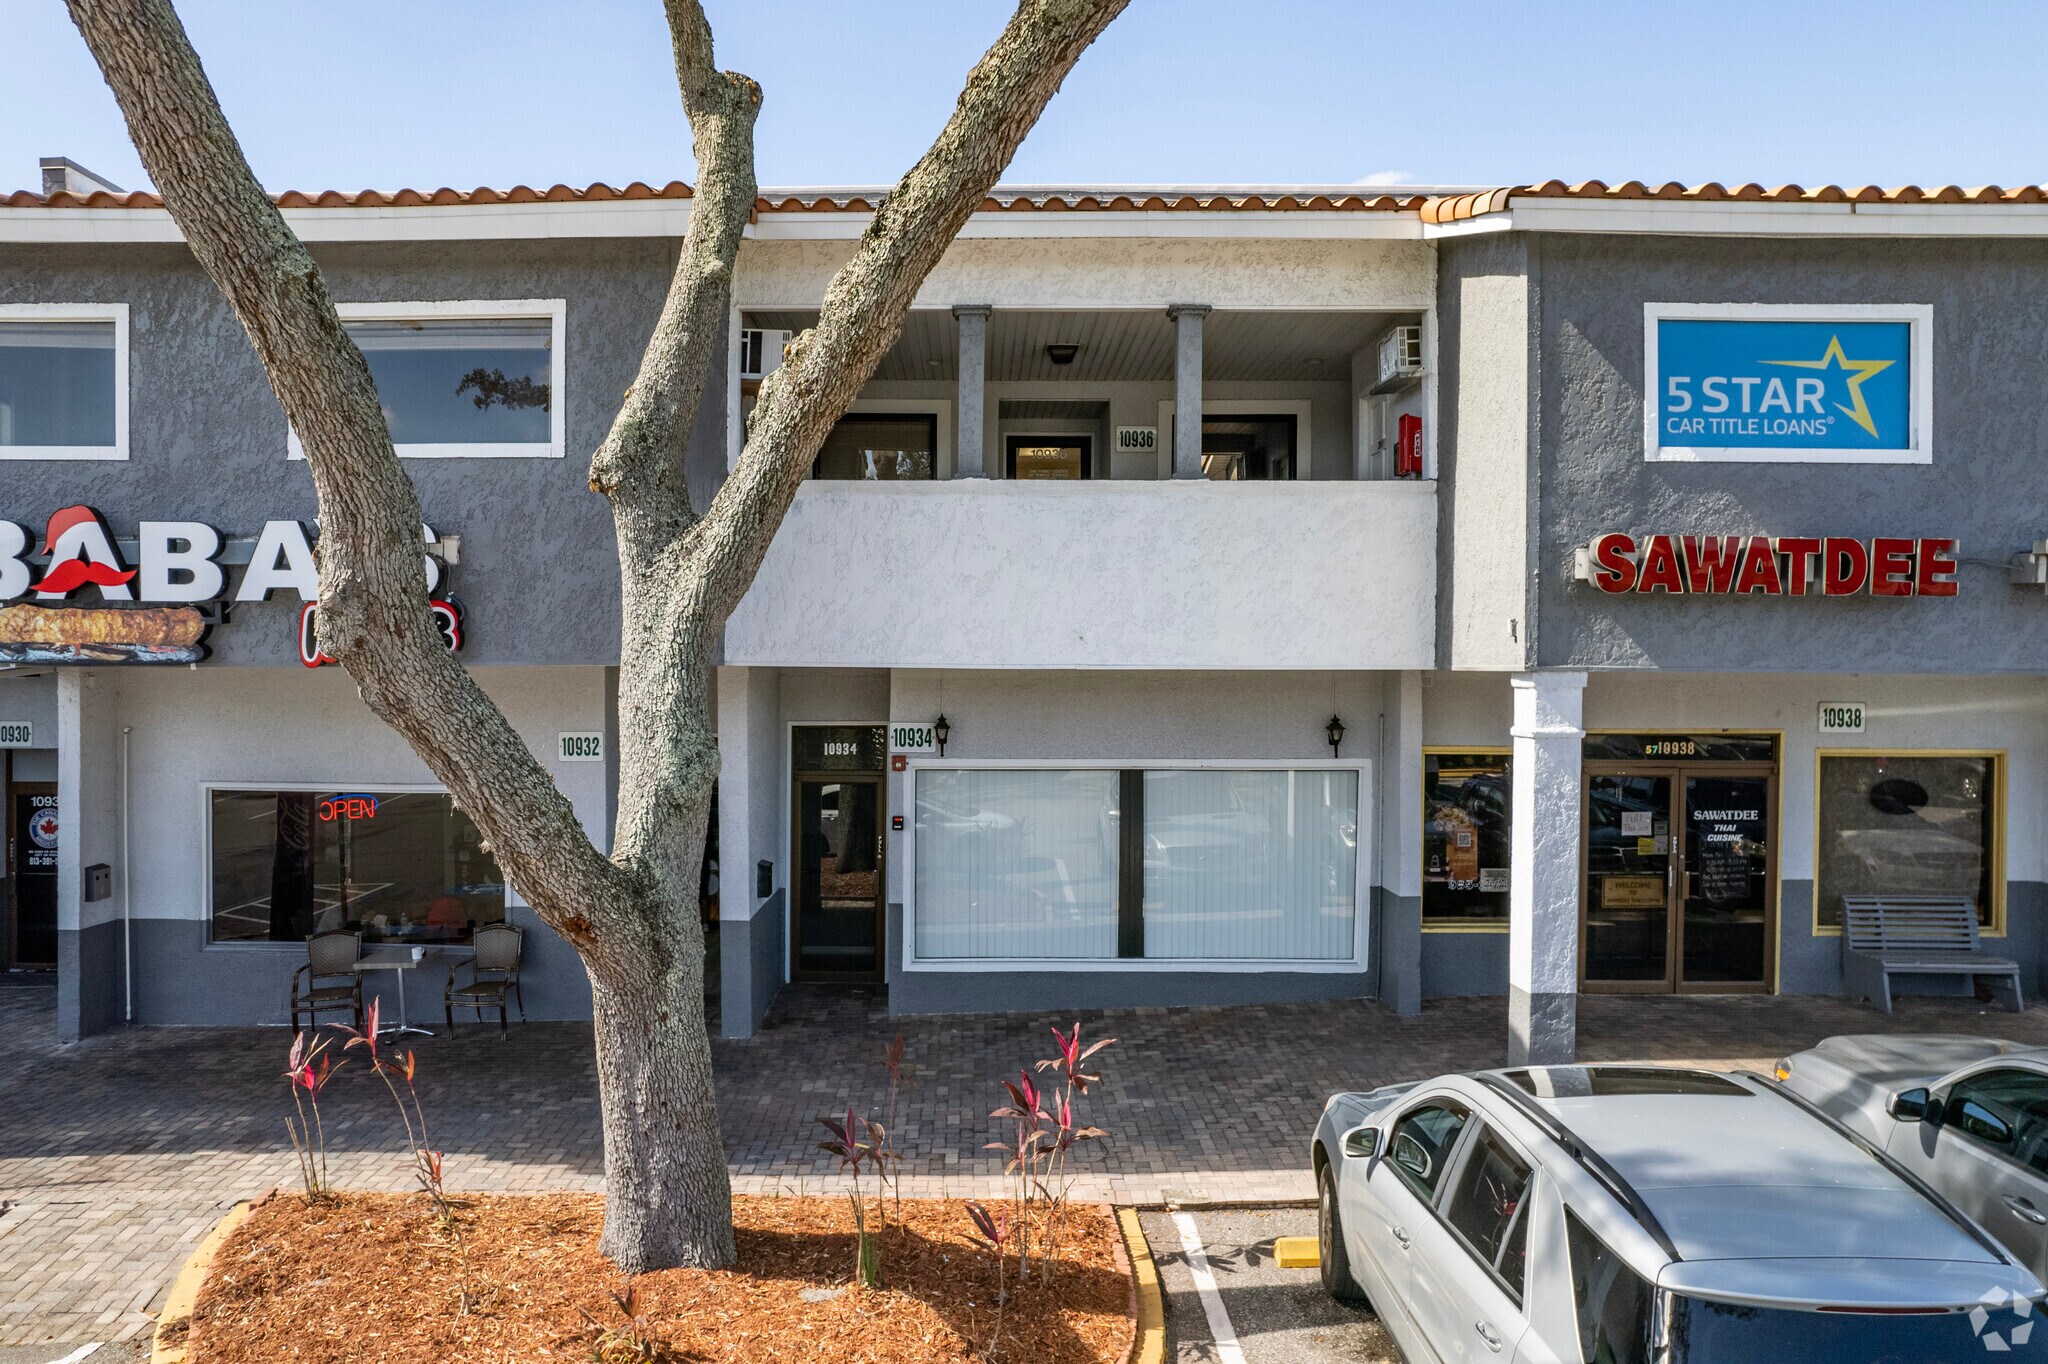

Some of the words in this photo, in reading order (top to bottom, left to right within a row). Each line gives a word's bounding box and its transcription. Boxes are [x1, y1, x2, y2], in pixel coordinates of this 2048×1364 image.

[1667, 376, 1693, 413] 5
[1702, 376, 1826, 414] STAR
[1667, 417, 1705, 434] CAR
[1709, 418, 1759, 435] TITLE
[1119, 430, 1154, 448] 10936
[1031, 449, 1067, 459] 10936
[1595, 532, 1960, 597] SAWATDEE
[1823, 708, 1862, 728] 10938
[562, 736, 600, 756] 10932
[893, 728, 932, 748] 10934
[824, 743, 857, 755] 10934
[319, 799, 375, 821] OPEN
[1693, 809, 1759, 820] SAWATDEE
[1713, 824, 1737, 832] THAI
[1706, 833, 1744, 842] CUISINE
[1615, 881, 1652, 889] WELCOME
